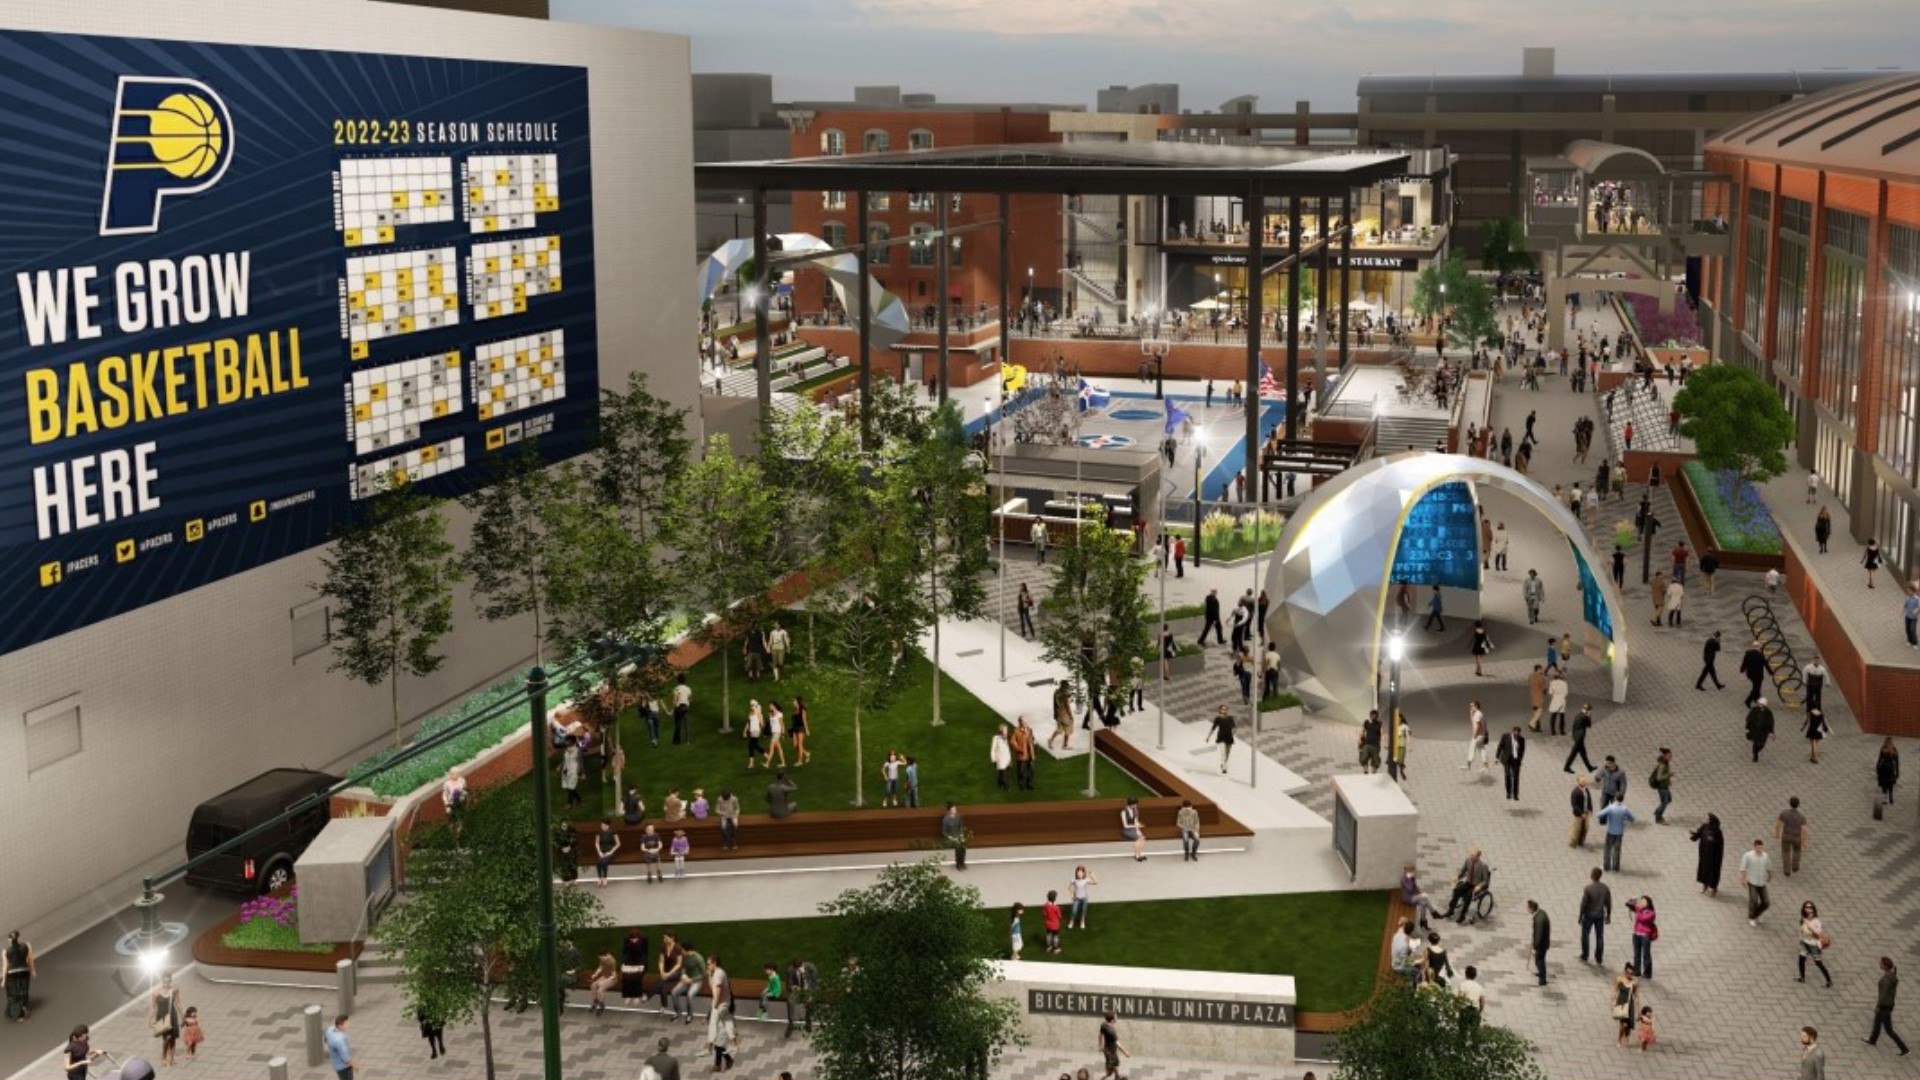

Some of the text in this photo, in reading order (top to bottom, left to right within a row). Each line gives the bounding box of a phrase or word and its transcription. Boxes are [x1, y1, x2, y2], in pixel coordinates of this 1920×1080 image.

[333, 120, 558, 144] 2022-23 SEASON SCHEDULE
[1337, 256, 1402, 267] STAURANT
[16, 250, 250, 347] WE GROW
[25, 327, 309, 446] BASKETBALL
[33, 440, 161, 541] HERE
[1034, 992, 1287, 1023] BICENTENNIAL UNITY PLAZA
